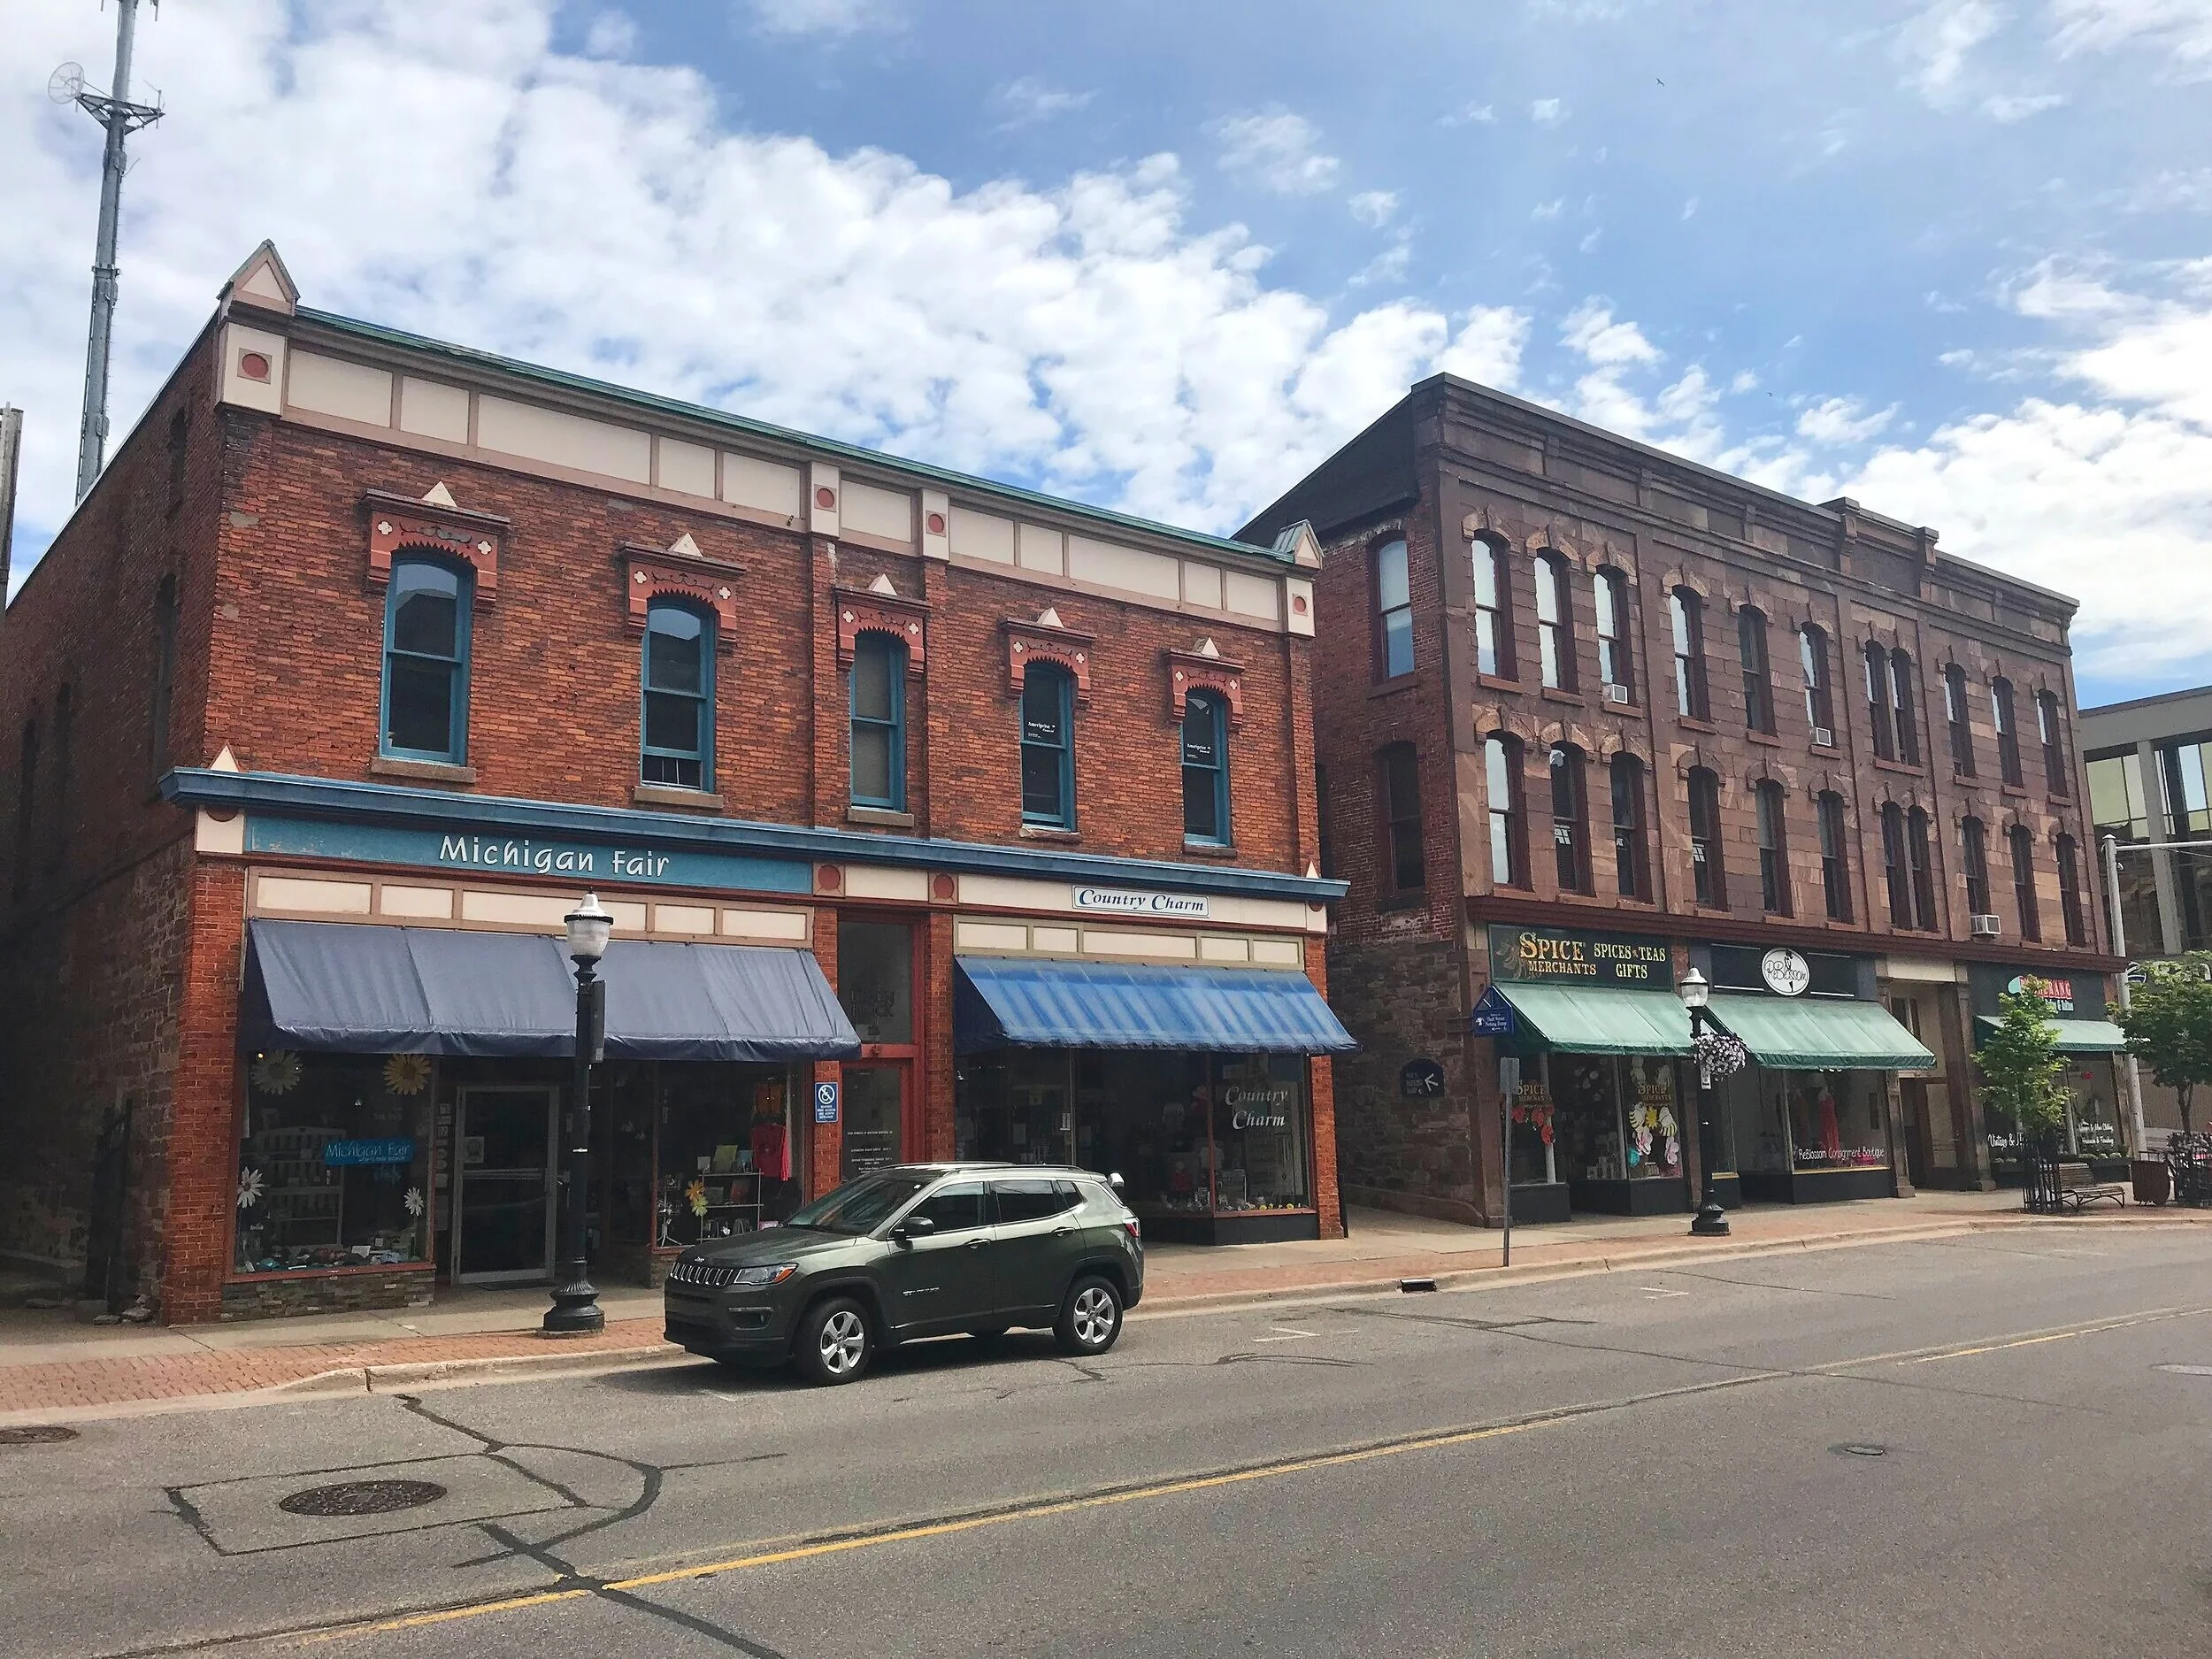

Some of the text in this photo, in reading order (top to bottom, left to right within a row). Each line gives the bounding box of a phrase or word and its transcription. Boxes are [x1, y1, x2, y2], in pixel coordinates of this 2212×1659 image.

[439, 835, 670, 877] Michigan Fair
[1079, 888, 1204, 911] Country Charm
[1594, 943, 1666, 962] SPICES TEAS
[1528, 960, 1597, 976] MERCHANTS
[1616, 964, 1648, 979] GIFTS
[1225, 1086, 1288, 1106] Country
[1233, 1110, 1286, 1130] Charm
[326, 1141, 411, 1158] Michigan Fair
[1798, 1146, 1885, 1161] ReBlossom Consignment Boutique
